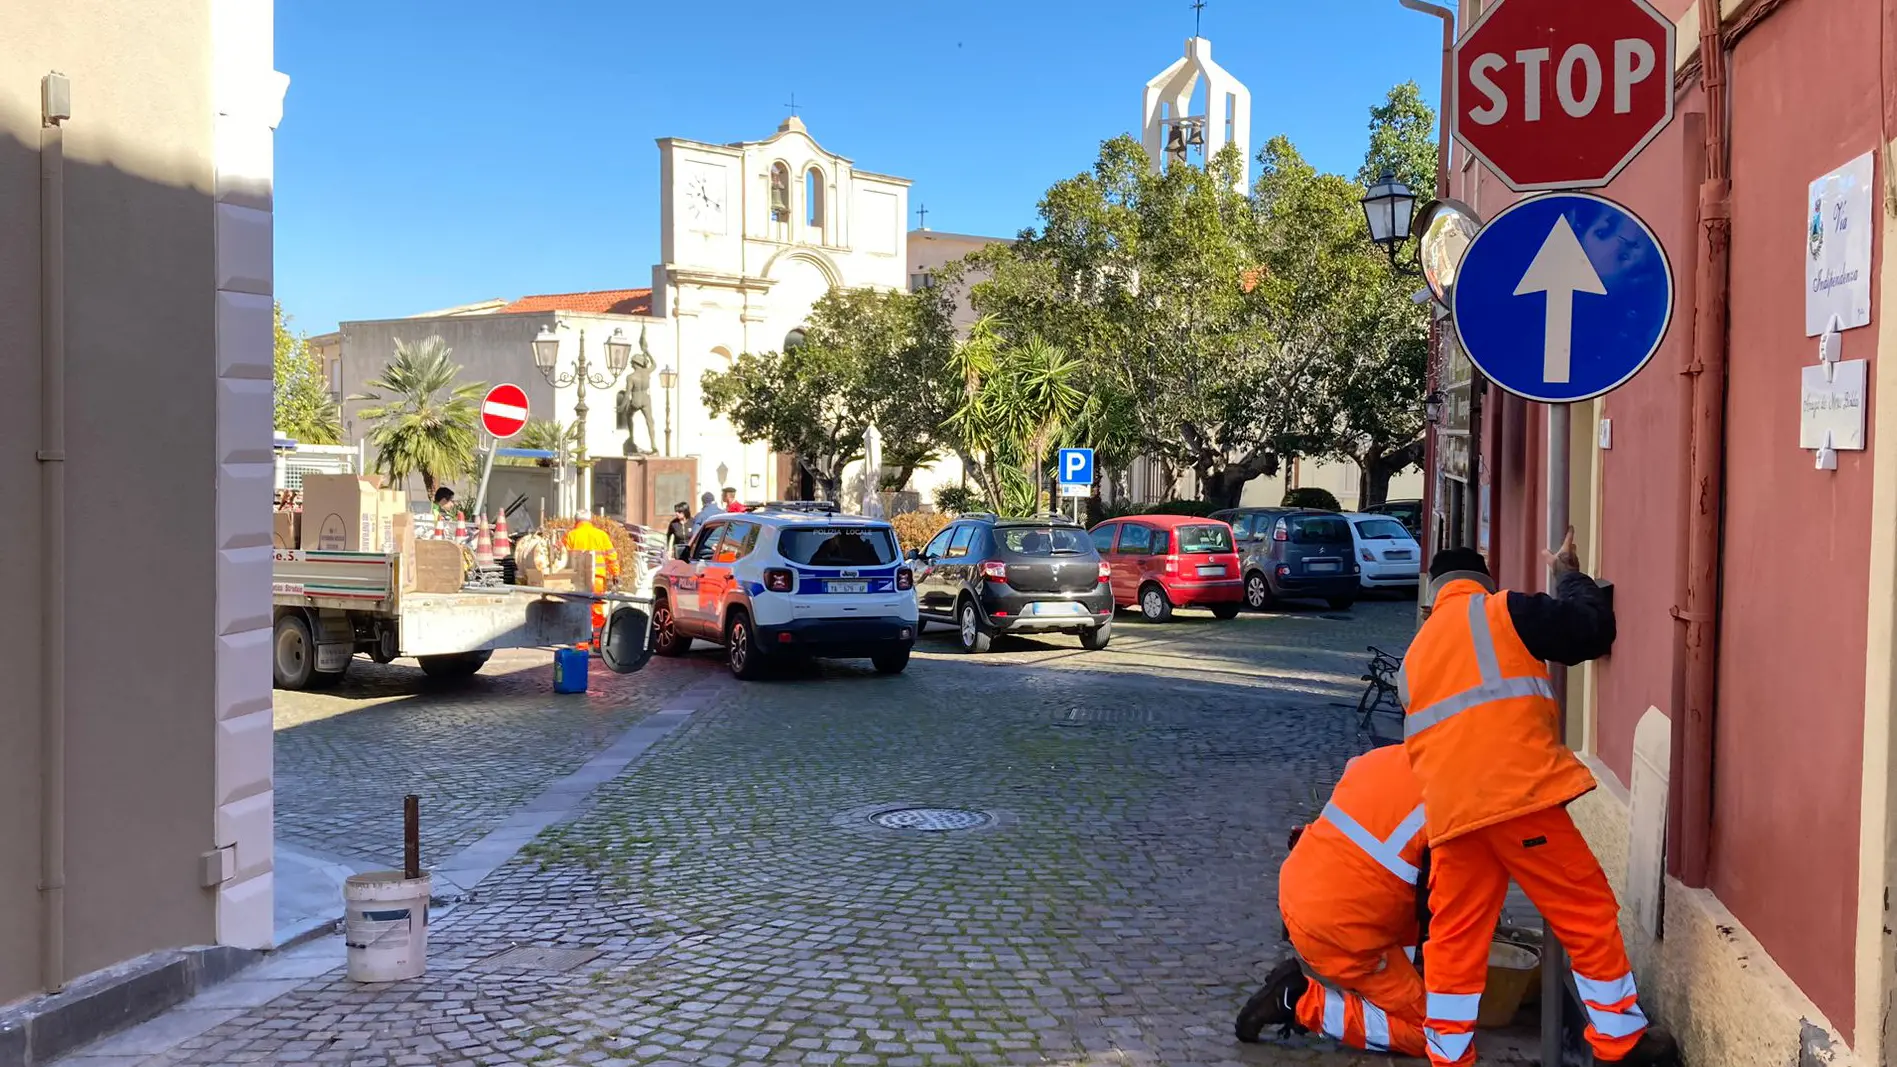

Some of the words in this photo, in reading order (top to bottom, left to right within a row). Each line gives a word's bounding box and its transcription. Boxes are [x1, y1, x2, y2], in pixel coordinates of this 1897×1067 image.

[1468, 38, 1656, 126] STOP
[1833, 201, 1848, 234] Via
[1812, 262, 1859, 297] Indipendenza
[1066, 452, 1086, 481] P
[812, 528, 842, 536] POLIZIA
[845, 528, 873, 536] LOCALE
[272, 551, 299, 562] e.S.
[841, 570, 858, 578] Jeep
